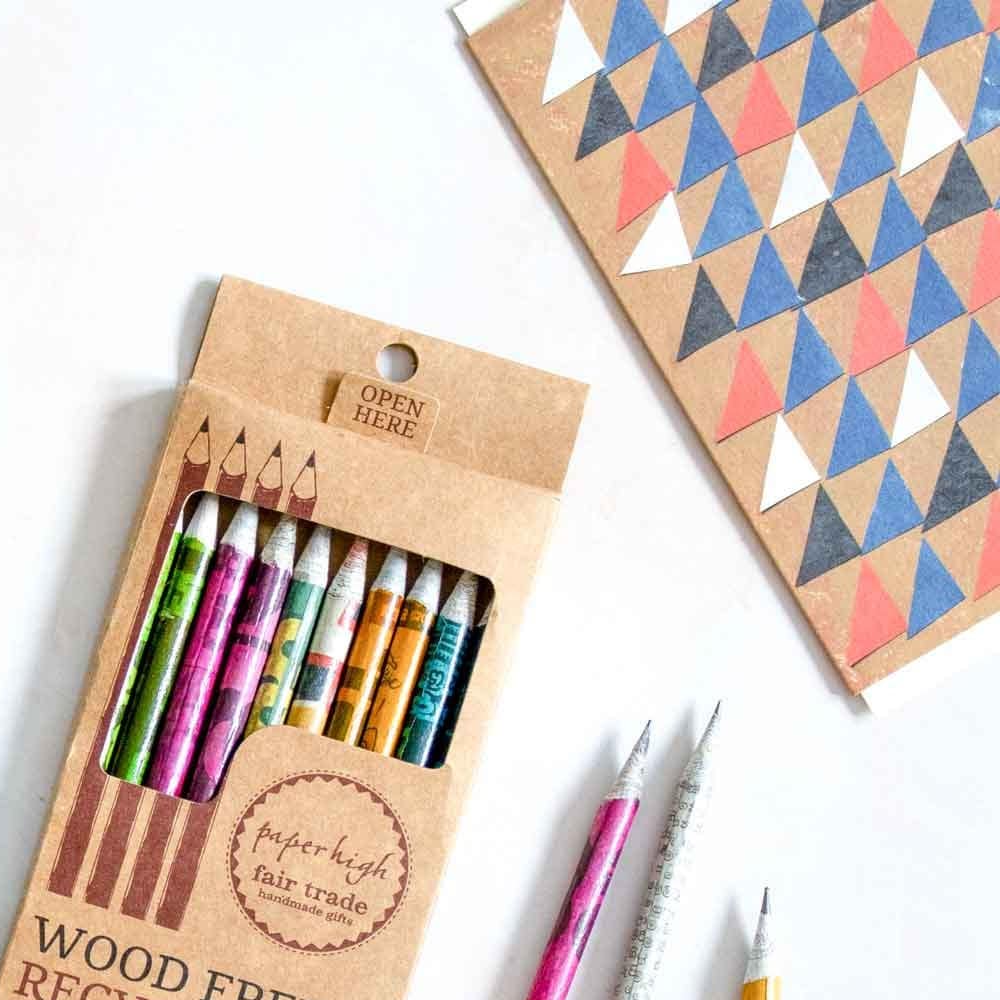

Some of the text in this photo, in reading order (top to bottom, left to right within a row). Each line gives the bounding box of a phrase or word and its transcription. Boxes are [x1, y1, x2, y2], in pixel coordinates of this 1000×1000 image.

[352, 404, 418, 439] HERE
[361, 385, 425, 418] OPEN
[252, 821, 394, 885] paper high
[251, 865, 368, 915] fair trade
[258, 888, 354, 927] handmade gifts
[34, 915, 190, 993] WOOD
